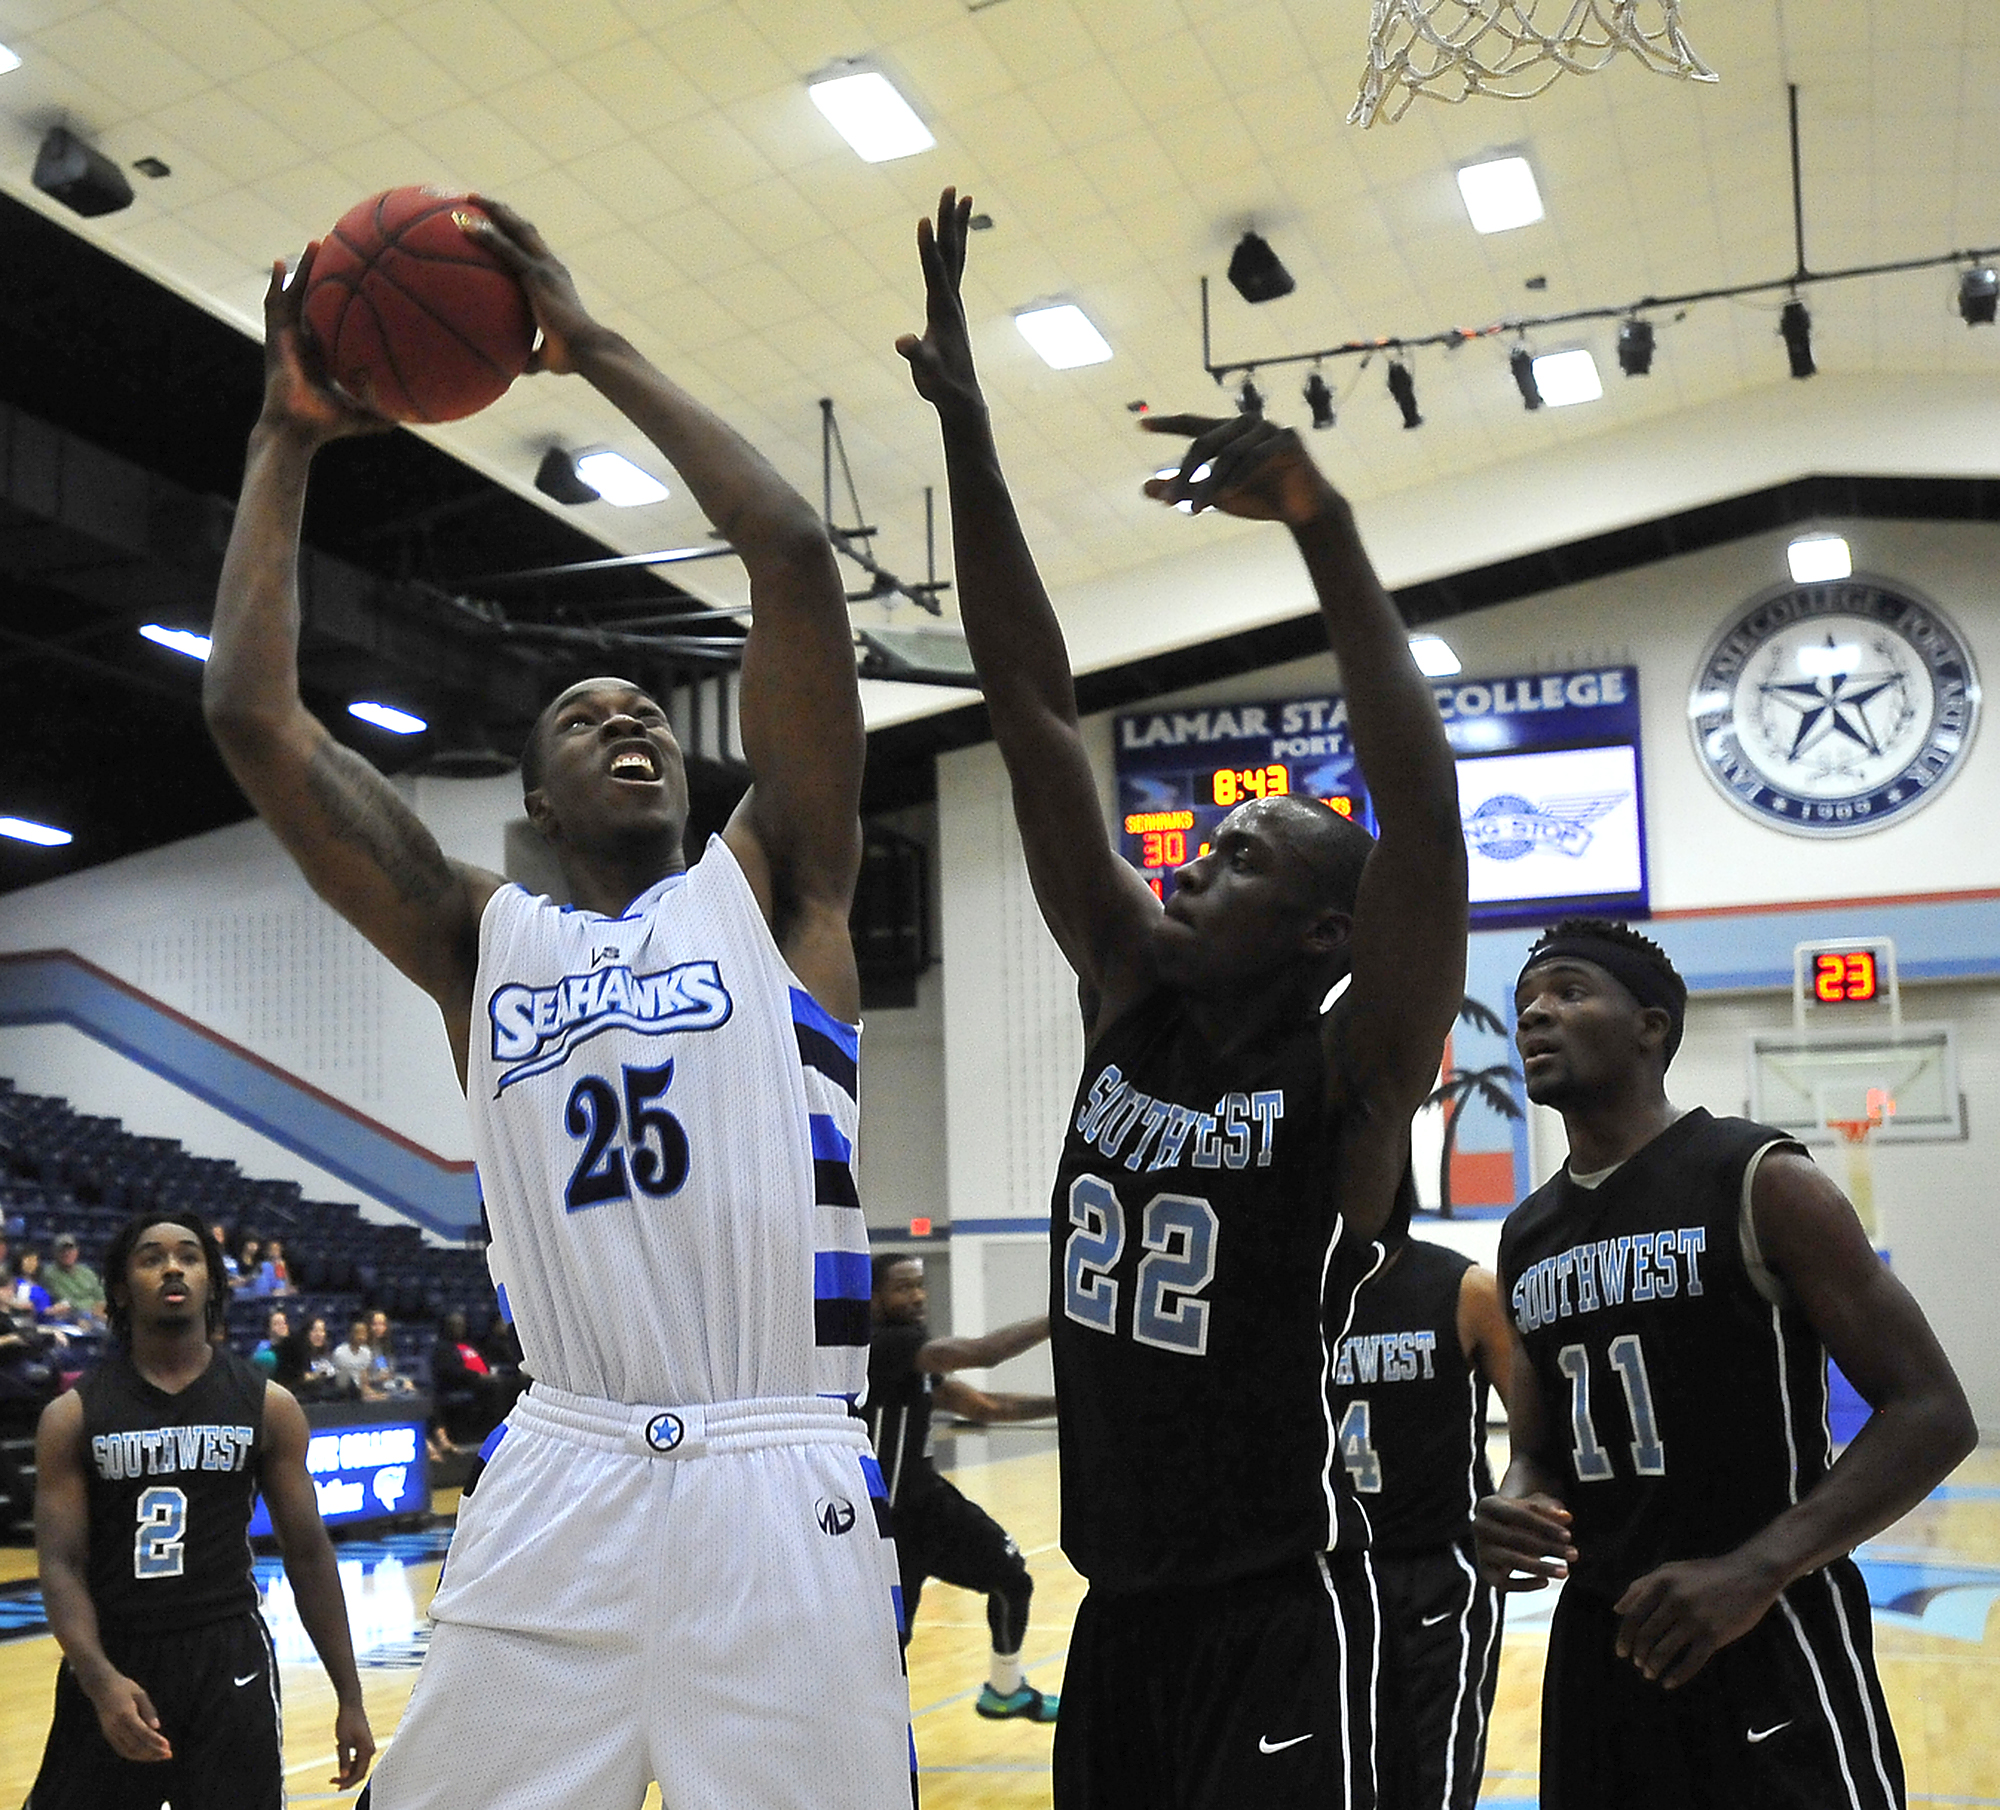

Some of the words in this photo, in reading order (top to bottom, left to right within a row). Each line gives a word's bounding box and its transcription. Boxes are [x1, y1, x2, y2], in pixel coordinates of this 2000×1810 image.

[1122, 707, 1271, 749] LAMAR
[1282, 700, 1349, 733] STA
[1434, 672, 1627, 719] COLLEGE
[1272, 733, 1343, 760] PORT
[1905, 678, 1970, 788] ARTUR
[1124, 810, 1195, 835] SEAHAWKS
[1212, 763, 1290, 807] 8:43
[1142, 830, 1188, 869] 30
[489, 960, 733, 1062] SEAHAWKS
[1816, 952, 1875, 1002] 23
[564, 1056, 690, 1215] 25
[1075, 1063, 1285, 1173] SOUTHEST
[1064, 1172, 1220, 1356] 22
[1511, 1226, 1707, 1335] SOUTHWEST
[1335, 1330, 1437, 1386] HWEST
[1557, 1333, 1667, 1483] 11
[92, 1424, 255, 1481] SOUTHWEST
[133, 1485, 188, 1580] 2
